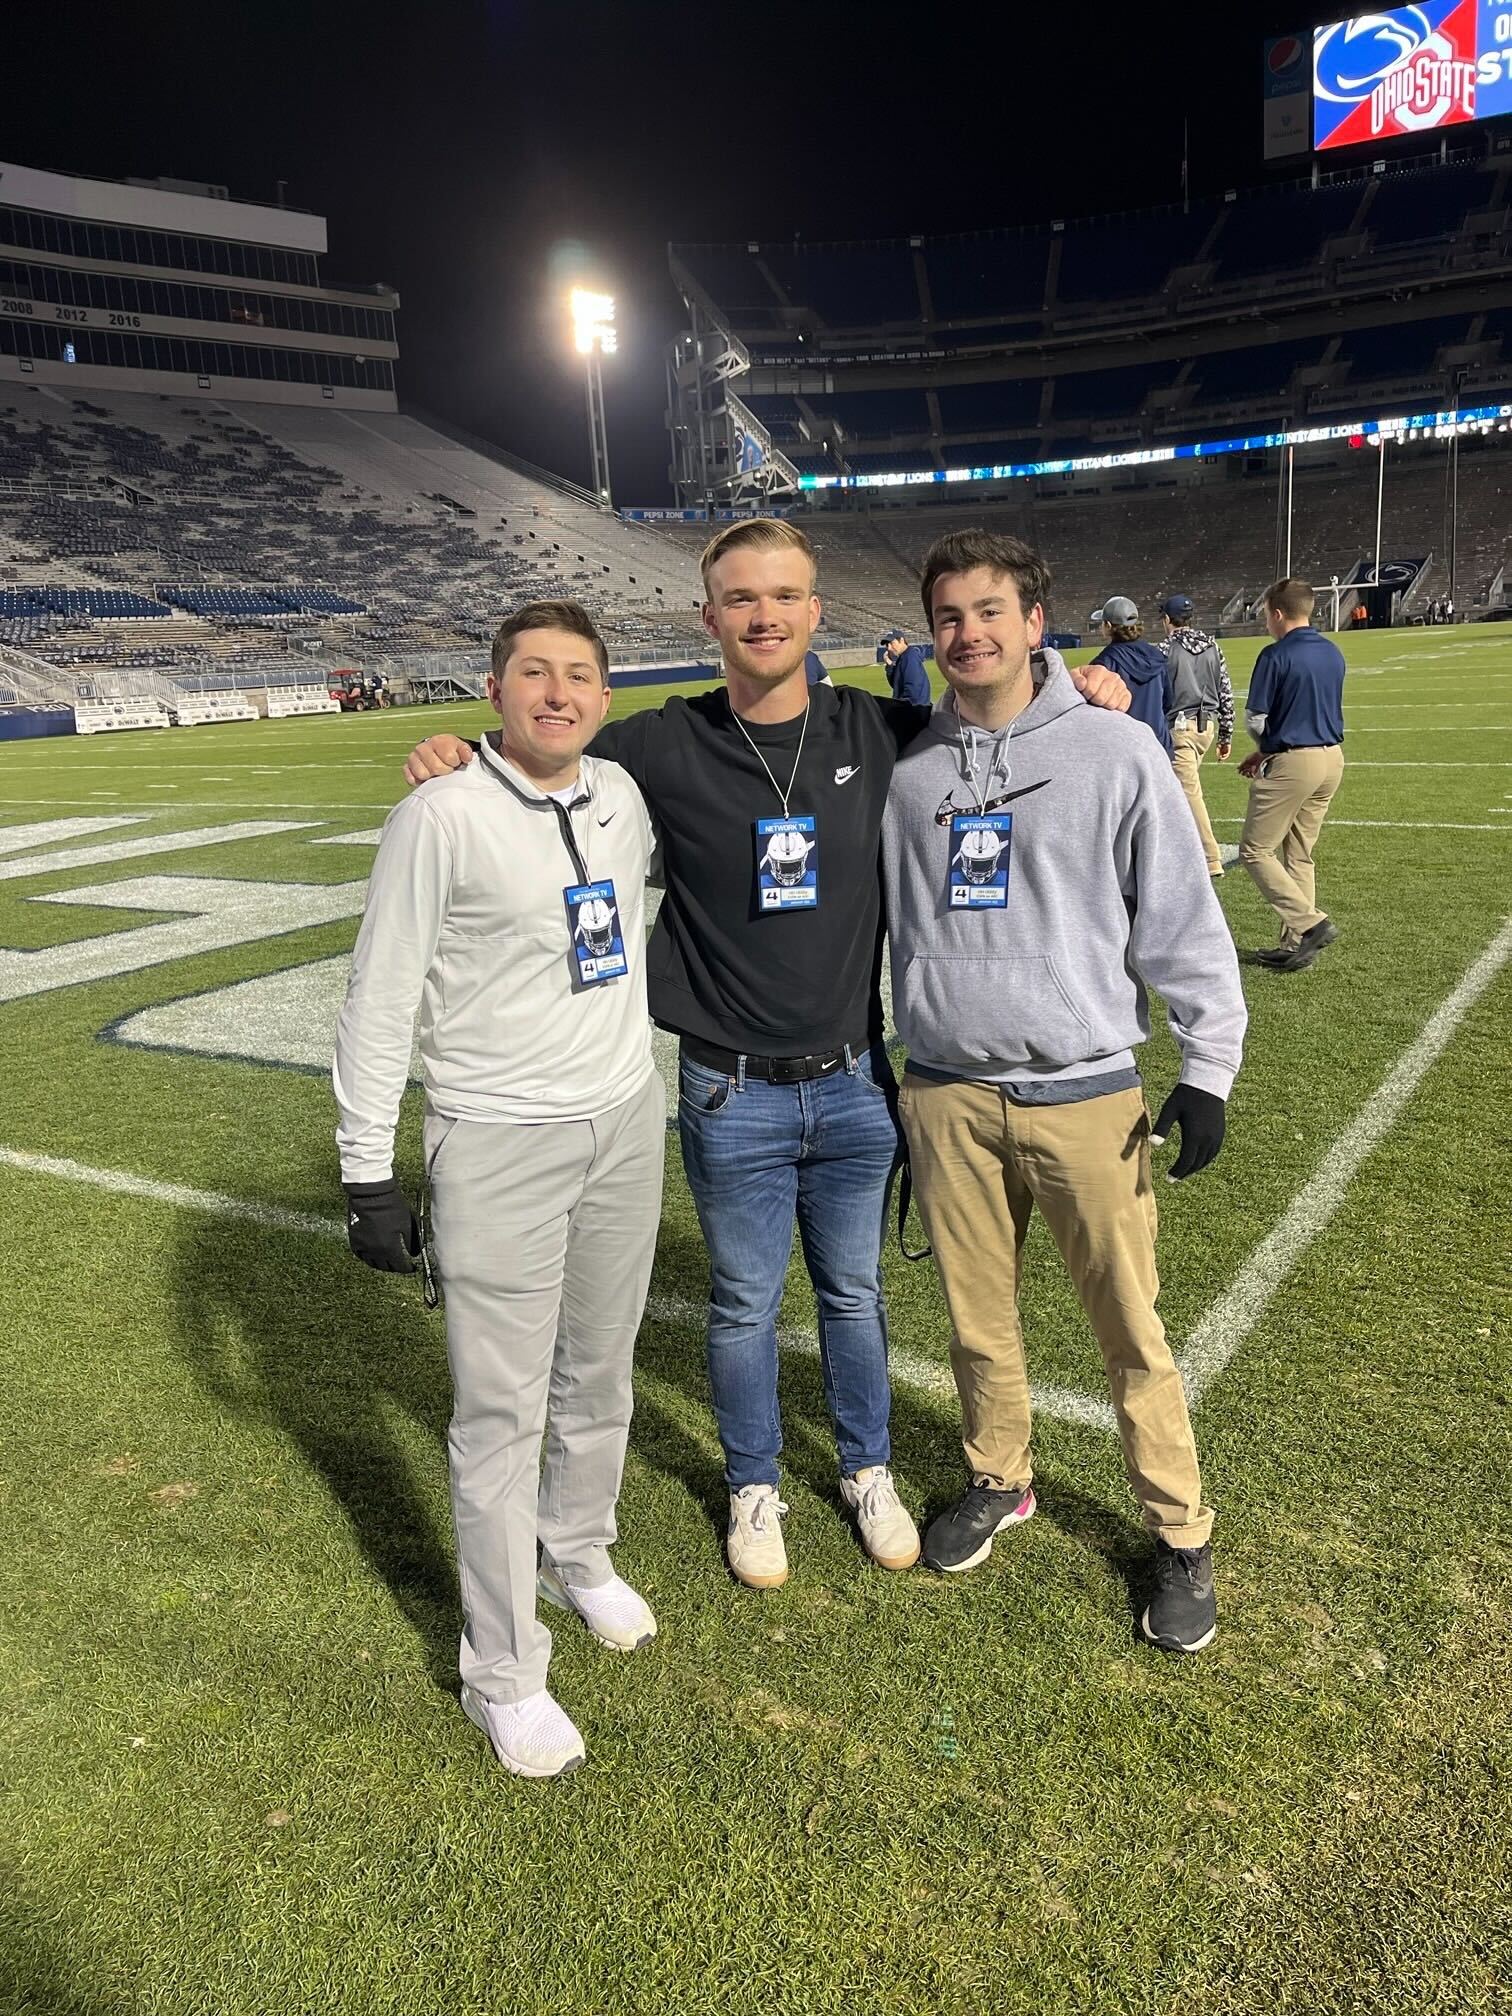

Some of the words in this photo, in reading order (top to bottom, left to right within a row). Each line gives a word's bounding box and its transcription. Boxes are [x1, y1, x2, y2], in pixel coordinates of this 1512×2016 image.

[1371, 67, 1416, 135] OHIO
[1415, 55, 1476, 117] STATE
[2, 300, 33, 315] 2008
[55, 307, 87, 322] 2012
[109, 313, 141, 328] 2016
[1331, 423, 1363, 438] LIONS
[907, 471, 934, 484] LIONS
[643, 510, 665, 519] PEPSI
[666, 510, 685, 519] ZONE
[732, 510, 753, 518] PEPSI
[754, 509, 776, 518] ZONE
[836, 765, 853, 778] NIKE
[765, 823, 798, 833] NETWORK
[798, 823, 808, 831] TV
[960, 822, 993, 830] NETWORK
[993, 821, 1003, 829] TV
[573, 891, 601, 902] NETWORK
[600, 889, 608, 898] TV
[765, 891, 778, 901] 4
[954, 889, 967, 898] 4
[584, 962, 595, 973] 4
